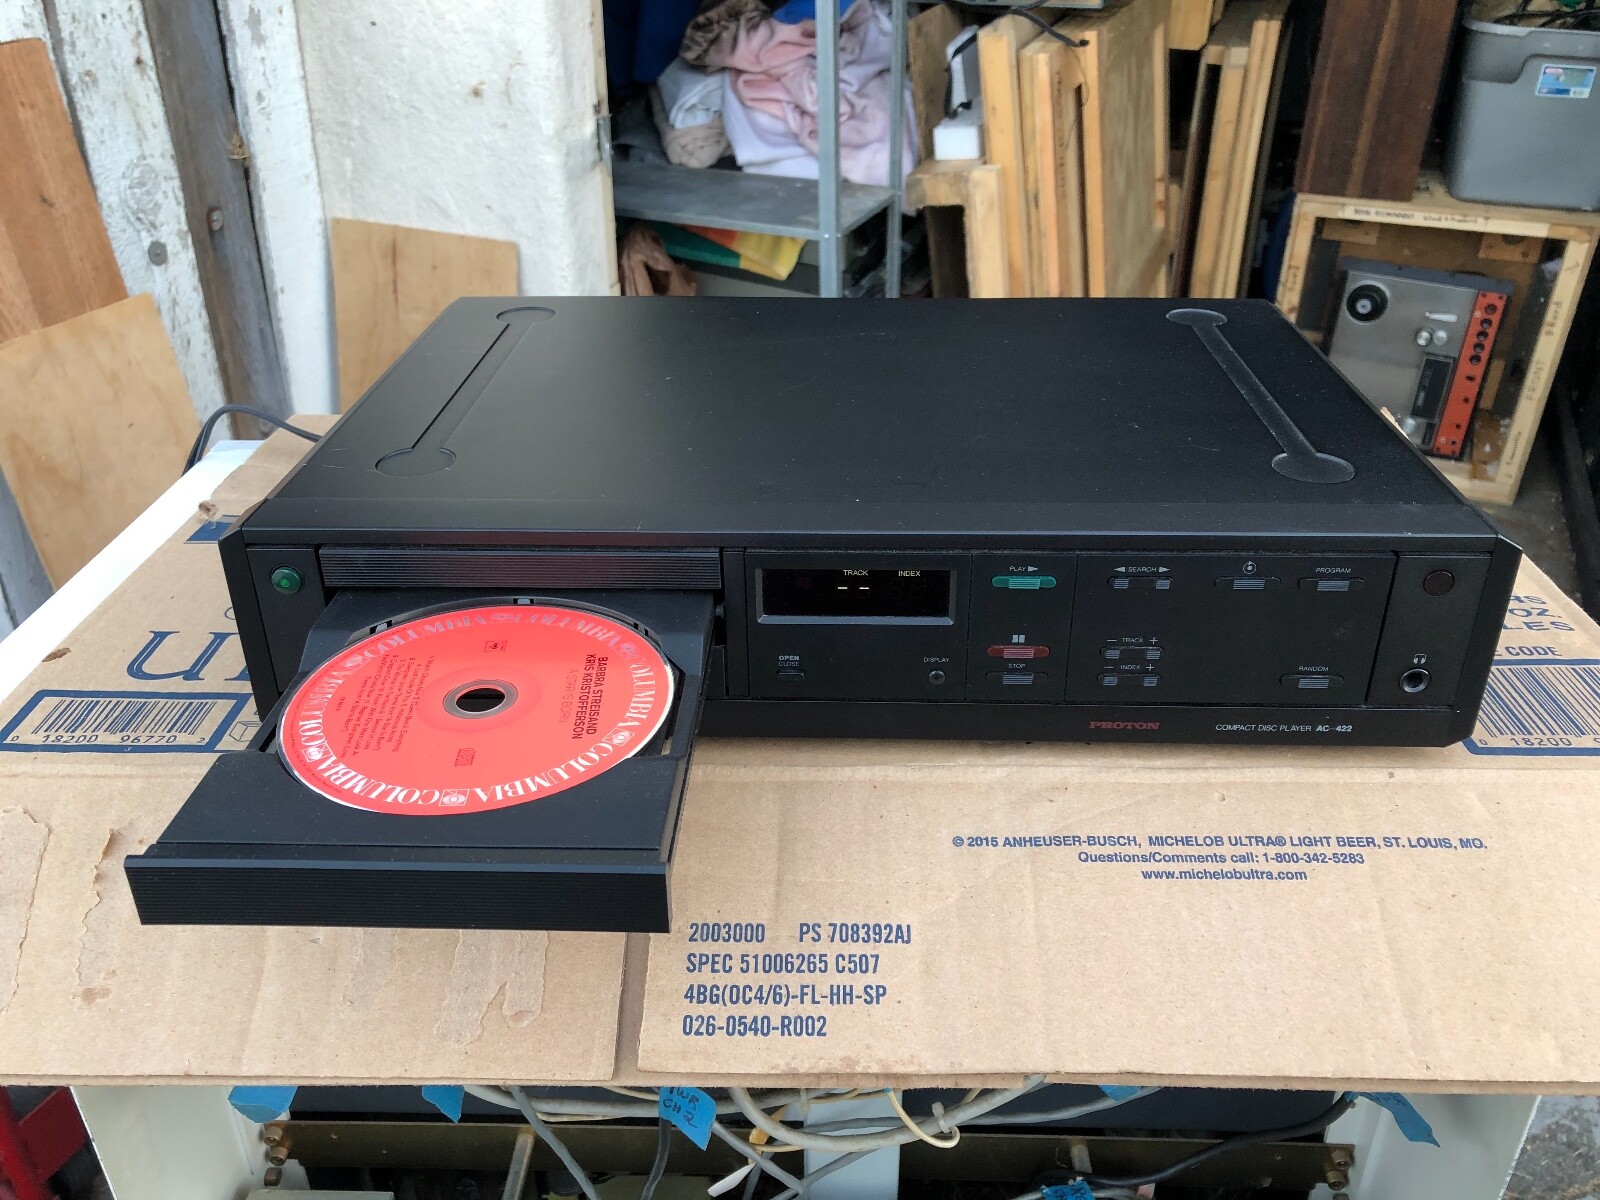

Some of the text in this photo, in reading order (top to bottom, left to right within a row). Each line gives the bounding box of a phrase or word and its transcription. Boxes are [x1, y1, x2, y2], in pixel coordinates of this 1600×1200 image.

[843, 569, 869, 577] TRACK
[1504, 645, 1563, 657] CODE
[571, 653, 598, 740] KRIS KRISTOFFERSON
[586, 656, 609, 735] BARBRA STREISAND
[617, 656, 657, 728] OLUMBIA
[299, 671, 353, 746] COLUMBIA
[1089, 721, 1160, 730] PROTON
[1257, 724, 1278, 732] DISC
[42, 735, 99, 743] 18200
[120, 735, 177, 743] 96770
[1510, 737, 1572, 747] 18200
[315, 755, 440, 805] COLUMBIA
[474, 742, 614, 803] COLUMBIA
[967, 836, 998, 848] 2015
[1002, 835, 1142, 849] ANHEUSER-BUSCH,
[1148, 835, 1225, 847] MICHELOB
[1290, 836, 1332, 847] LIGHT
[1336, 836, 1381, 849] BEER,
[1383, 837, 1406, 848] ST.
[1408, 837, 1457, 850] LOUIS,
[1459, 837, 1488, 850] MO.
[1078, 851, 1366, 865] Questions/Comments call: 1-800-342-5283
[1141, 868, 1308, 881] www.michelobultra.com
[688, 922, 912, 945] 2003000 PS 708392AJ
[685, 953, 880, 974] SPEC 51006265 C507
[682, 1014, 828, 1037] 026-0540-R002
